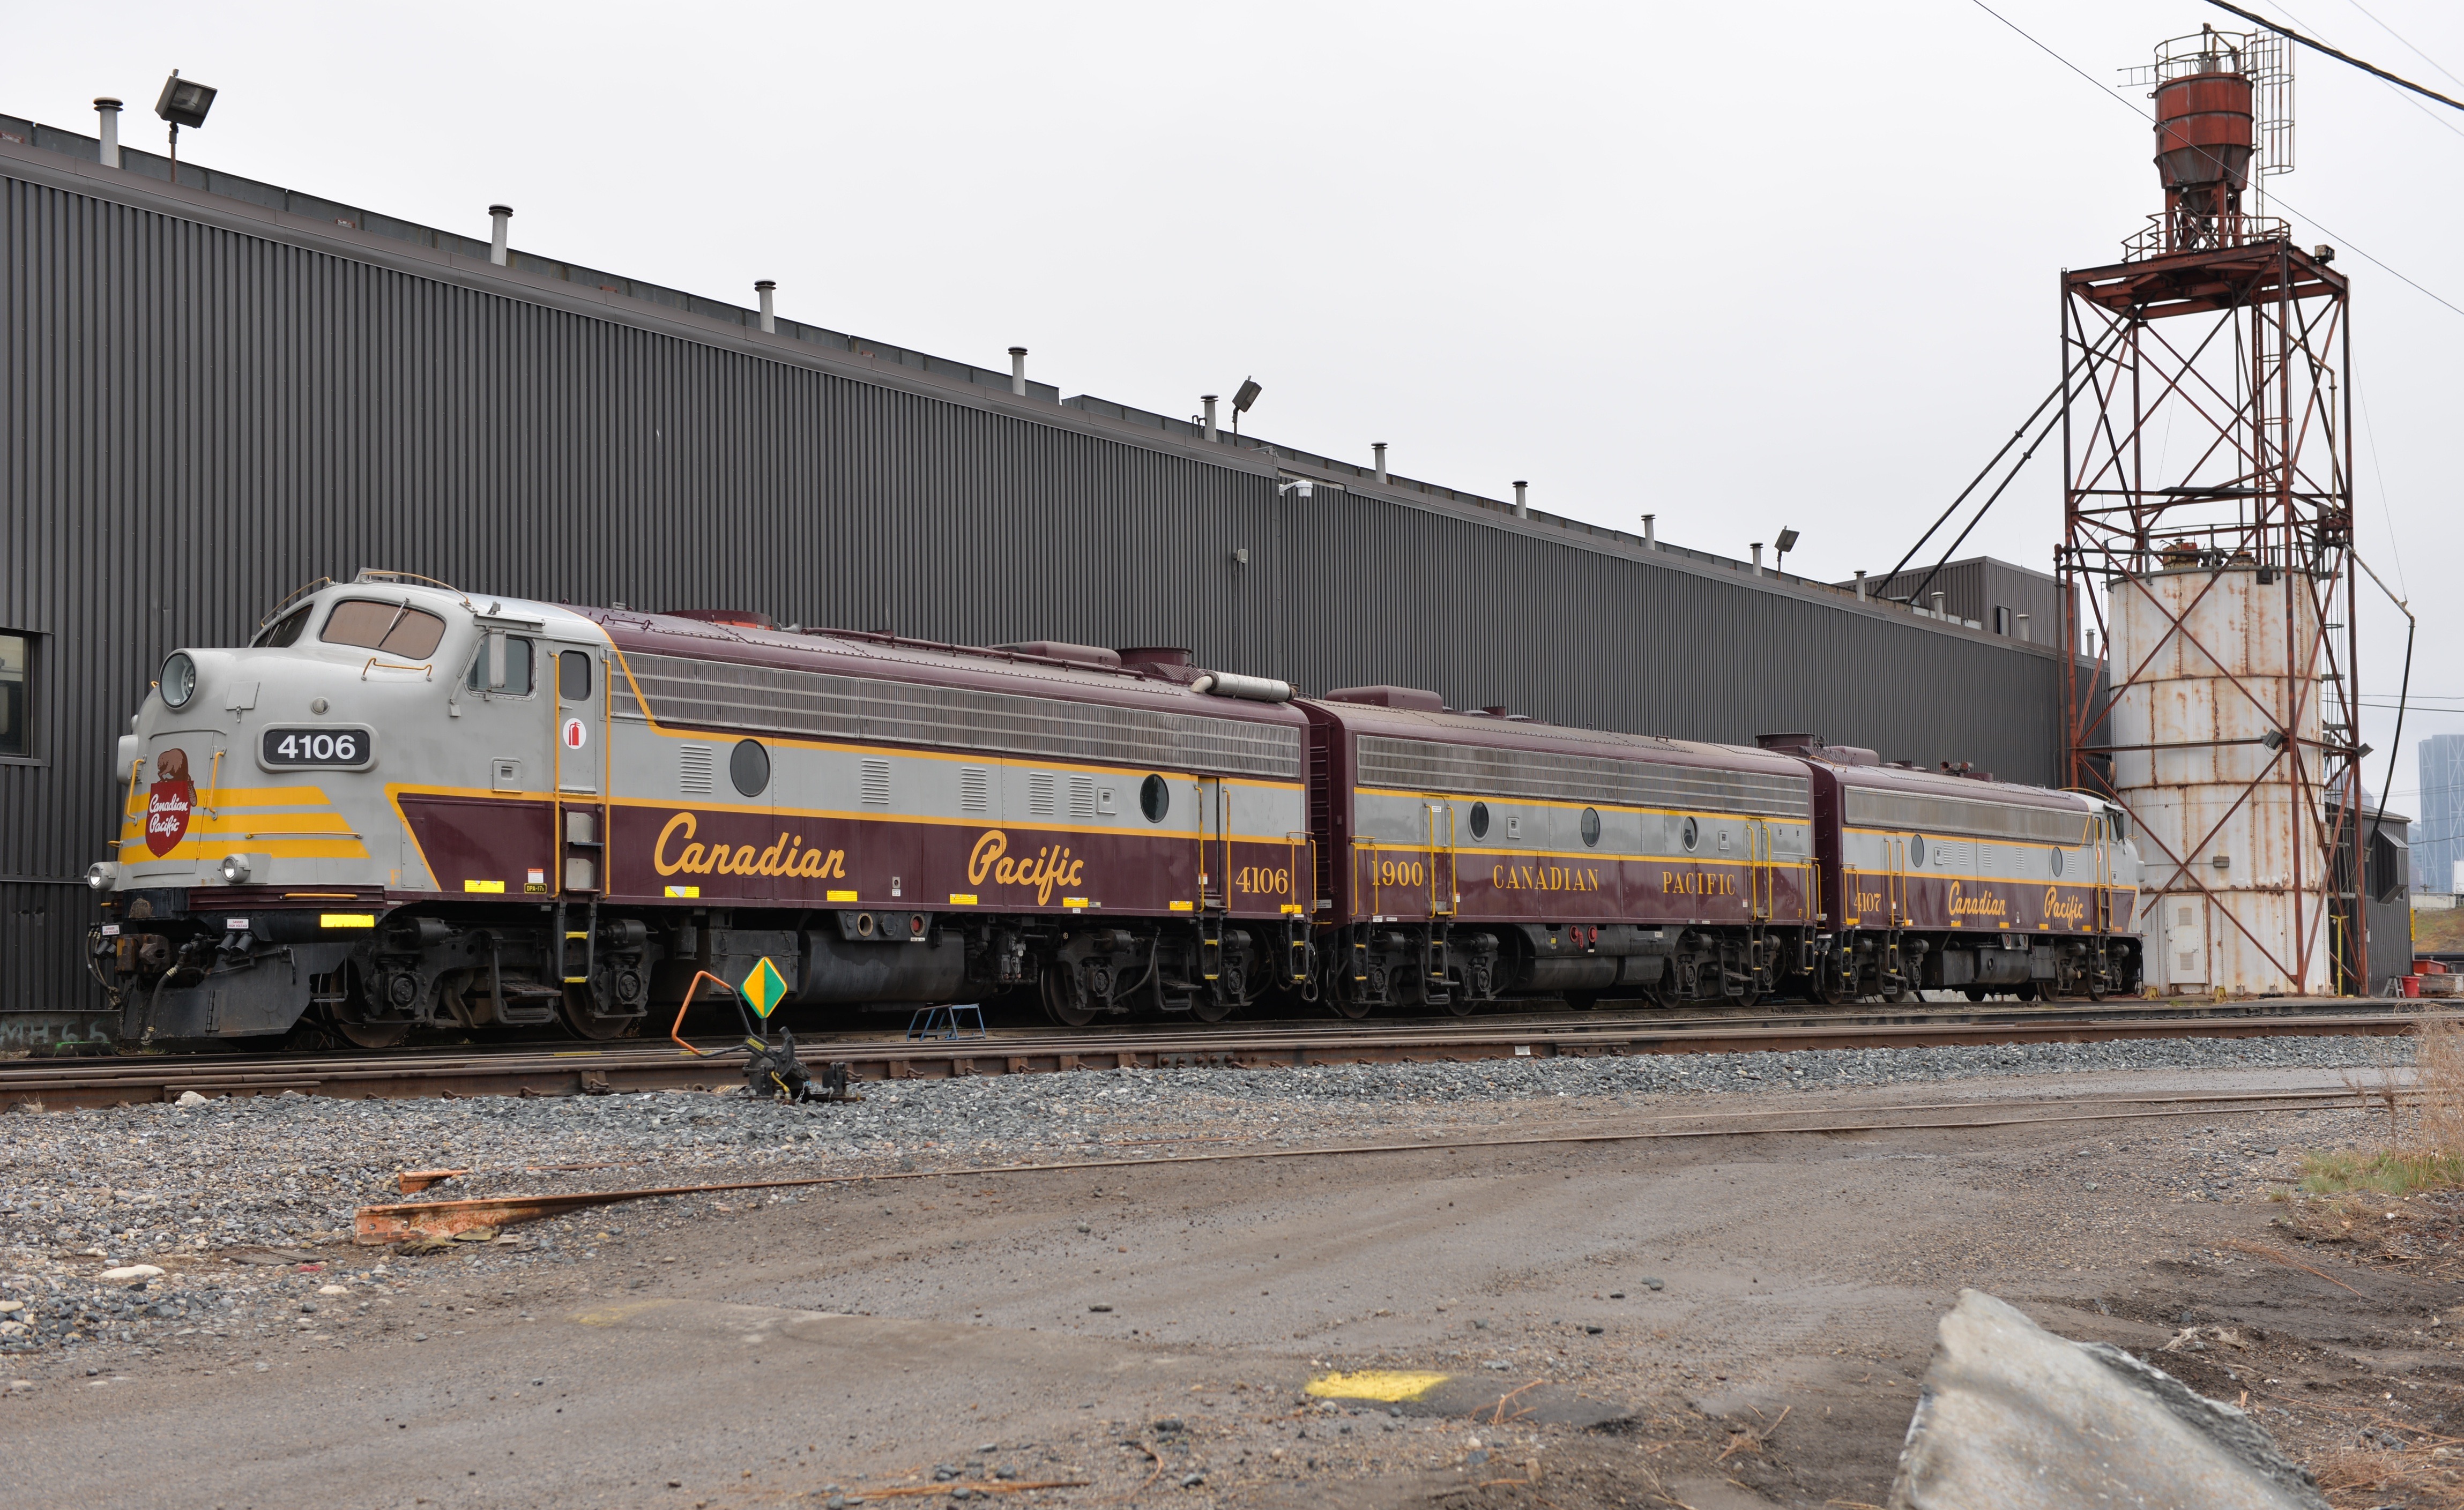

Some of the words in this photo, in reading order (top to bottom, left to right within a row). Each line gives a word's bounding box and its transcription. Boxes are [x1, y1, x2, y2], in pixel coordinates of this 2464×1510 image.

[278, 735, 356, 759] 4106
[149, 794, 188, 813] Canadian
[149, 813, 180, 837] Pacific
[654, 812, 846, 878] Canadian
[968, 829, 1084, 906] Pacific
[389, 869, 402, 885] F
[1235, 866, 1288, 894] 4106
[1372, 861, 1423, 886] 1900
[1493, 864, 1598, 892] CANADIAN
[1662, 871, 1735, 895] PACIFIC
[1853, 892, 1881, 912] 4107
[1948, 880, 2006, 916] Canadian
[2044, 886, 2083, 929] Pacific
